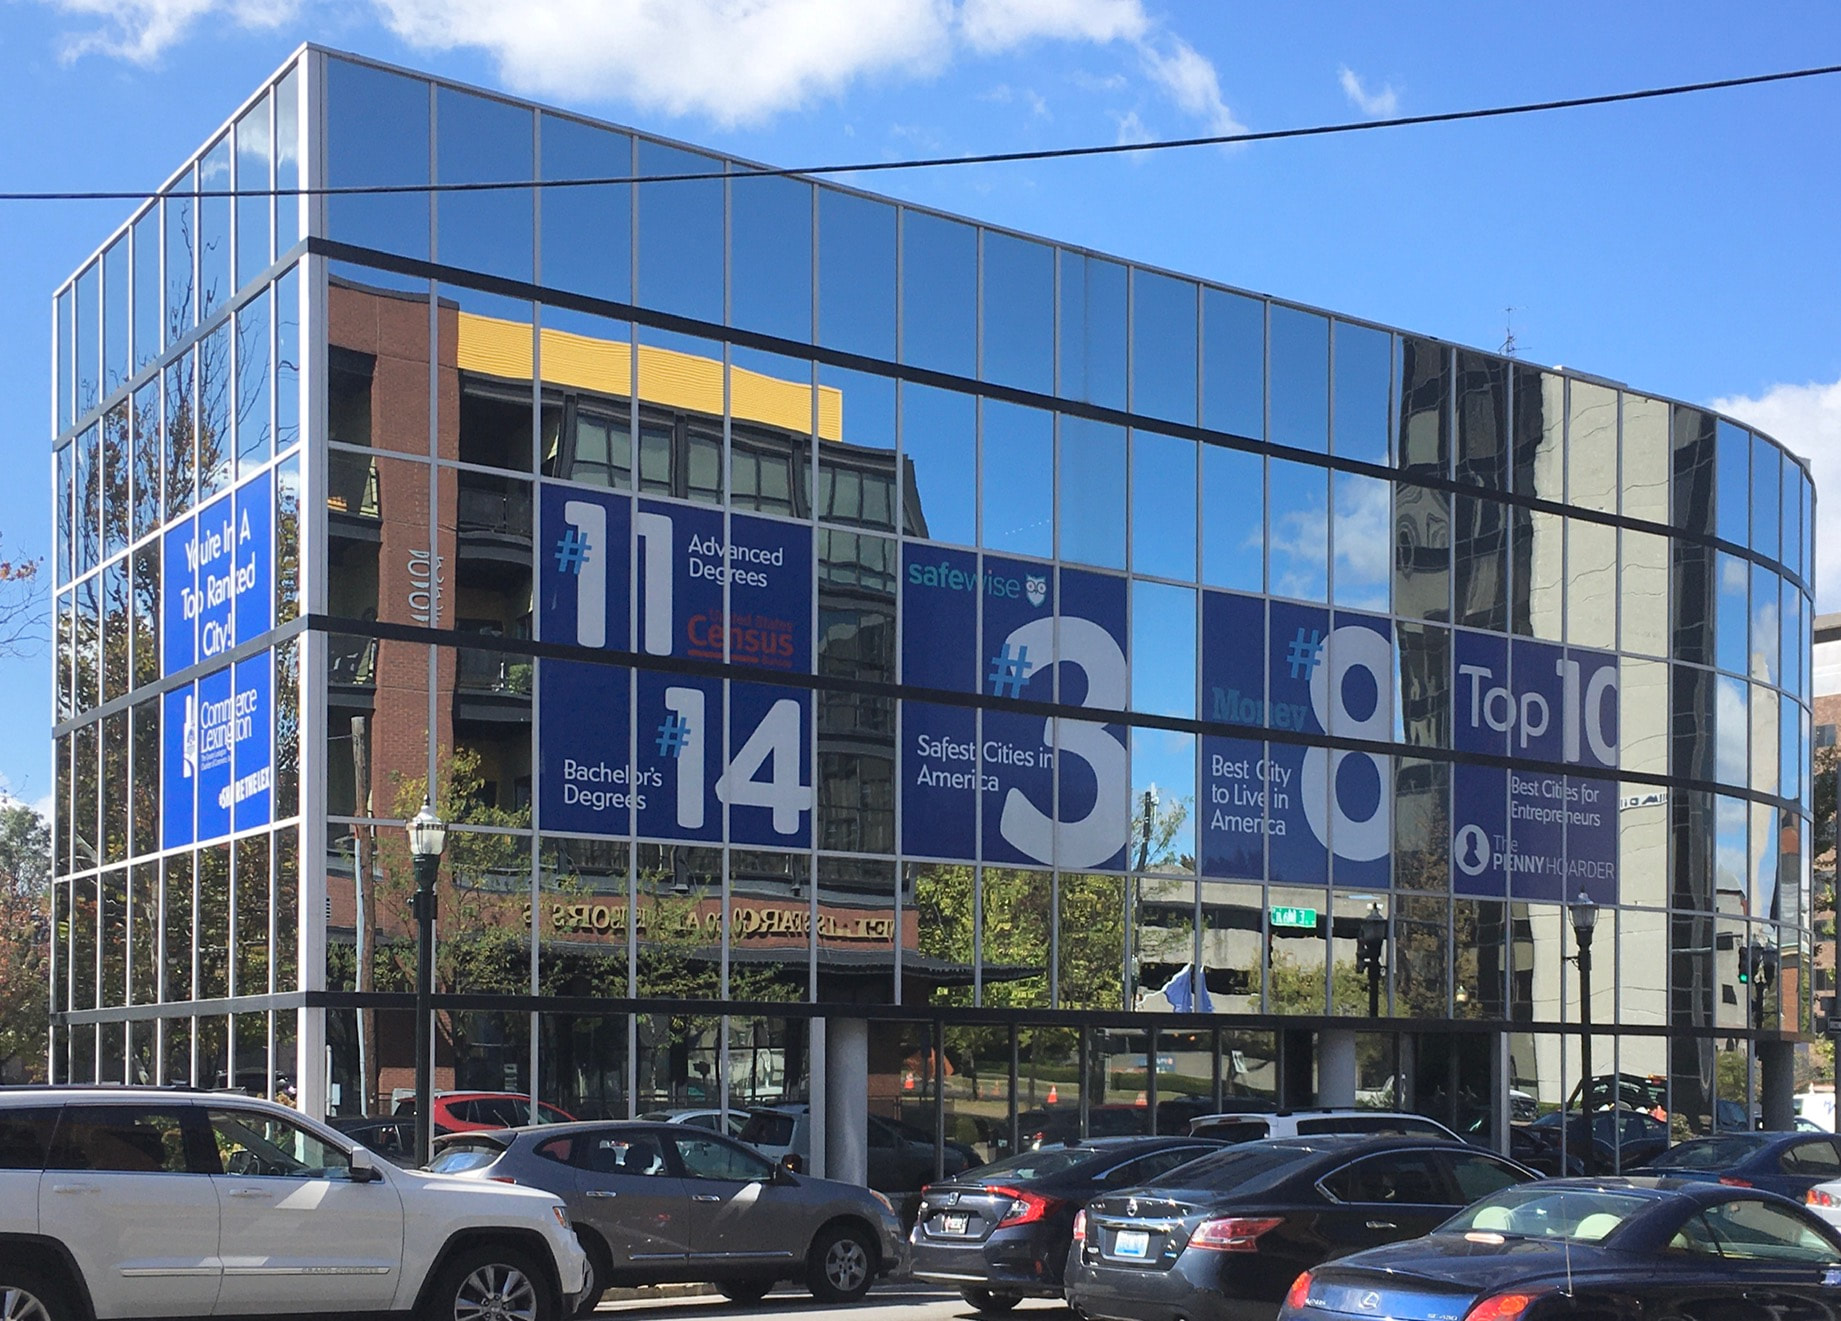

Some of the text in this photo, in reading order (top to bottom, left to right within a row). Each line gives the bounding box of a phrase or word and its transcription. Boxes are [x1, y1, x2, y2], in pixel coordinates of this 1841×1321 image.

[185, 529, 221, 572] You're
[240, 508, 251, 545] A
[688, 534, 783, 566] Advanced
[690, 557, 767, 587] Degrees
[909, 562, 1020, 599] safewise
[181, 587, 204, 621] Top
[687, 614, 794, 656] Census
[200, 688, 258, 729] Commerce
[1212, 687, 1308, 732] Money
[1458, 658, 1617, 767] Top 10
[200, 715, 253, 754] Lexington
[988, 616, 1127, 869] #3
[1286, 625, 1392, 862] #8
[917, 735, 1055, 769] Safest Cities in
[564, 759, 662, 787] Bachelor's
[917, 764, 999, 791] America
[1212, 754, 1291, 788] Best City
[564, 784, 647, 811] Degrees
[1212, 783, 1289, 809] to Live in
[1511, 776, 1539, 796] Best
[1542, 780, 1579, 801] Cities
[1581, 784, 1600, 805] for
[1211, 809, 1286, 836] America
[1511, 801, 1601, 827] Entrepreneurs
[1493, 835, 1518, 852] The
